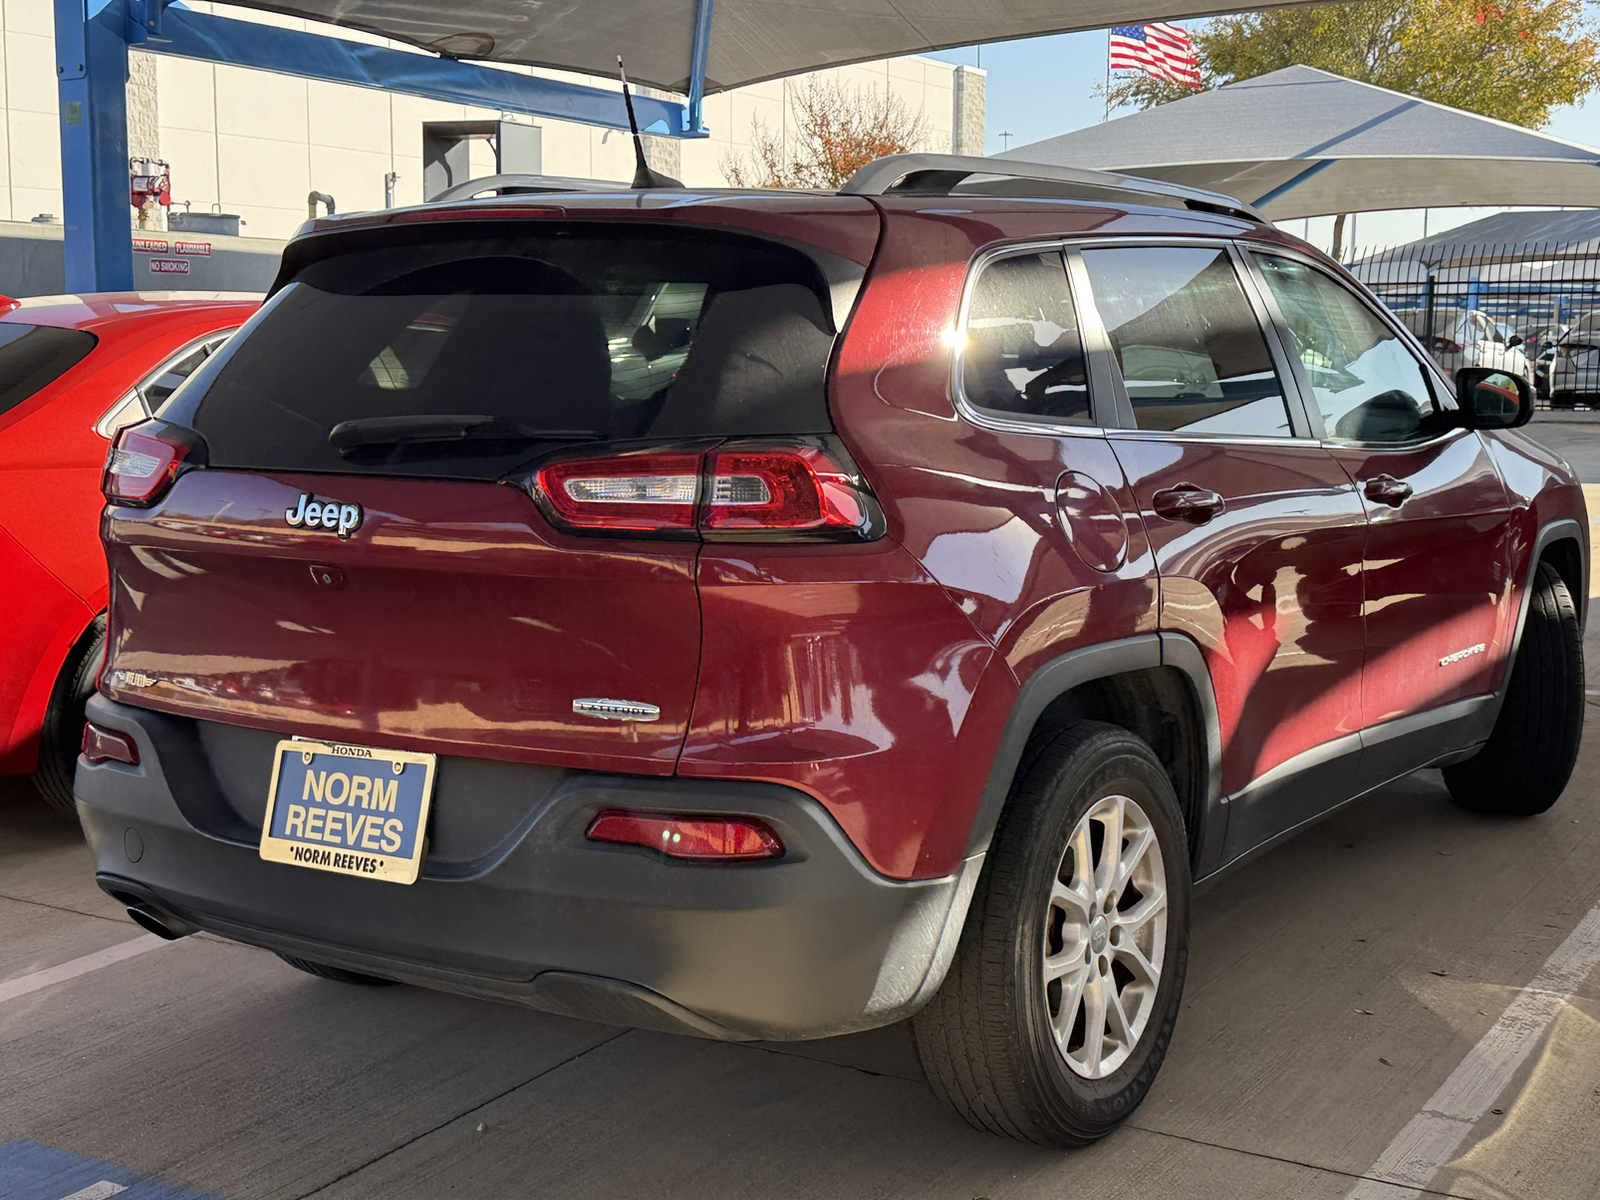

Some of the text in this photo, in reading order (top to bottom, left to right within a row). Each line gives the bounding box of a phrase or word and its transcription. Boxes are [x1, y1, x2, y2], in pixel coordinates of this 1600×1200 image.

[176, 243, 210, 254] FLAMMABLE
[151, 261, 188, 272] NO SMOKING
[285, 492, 362, 538] Jeep
[331, 746, 373, 758] HONDA
[302, 769, 398, 813] NORM
[284, 804, 404, 853] REEVES
[294, 846, 378, 874] NORM REEVES
